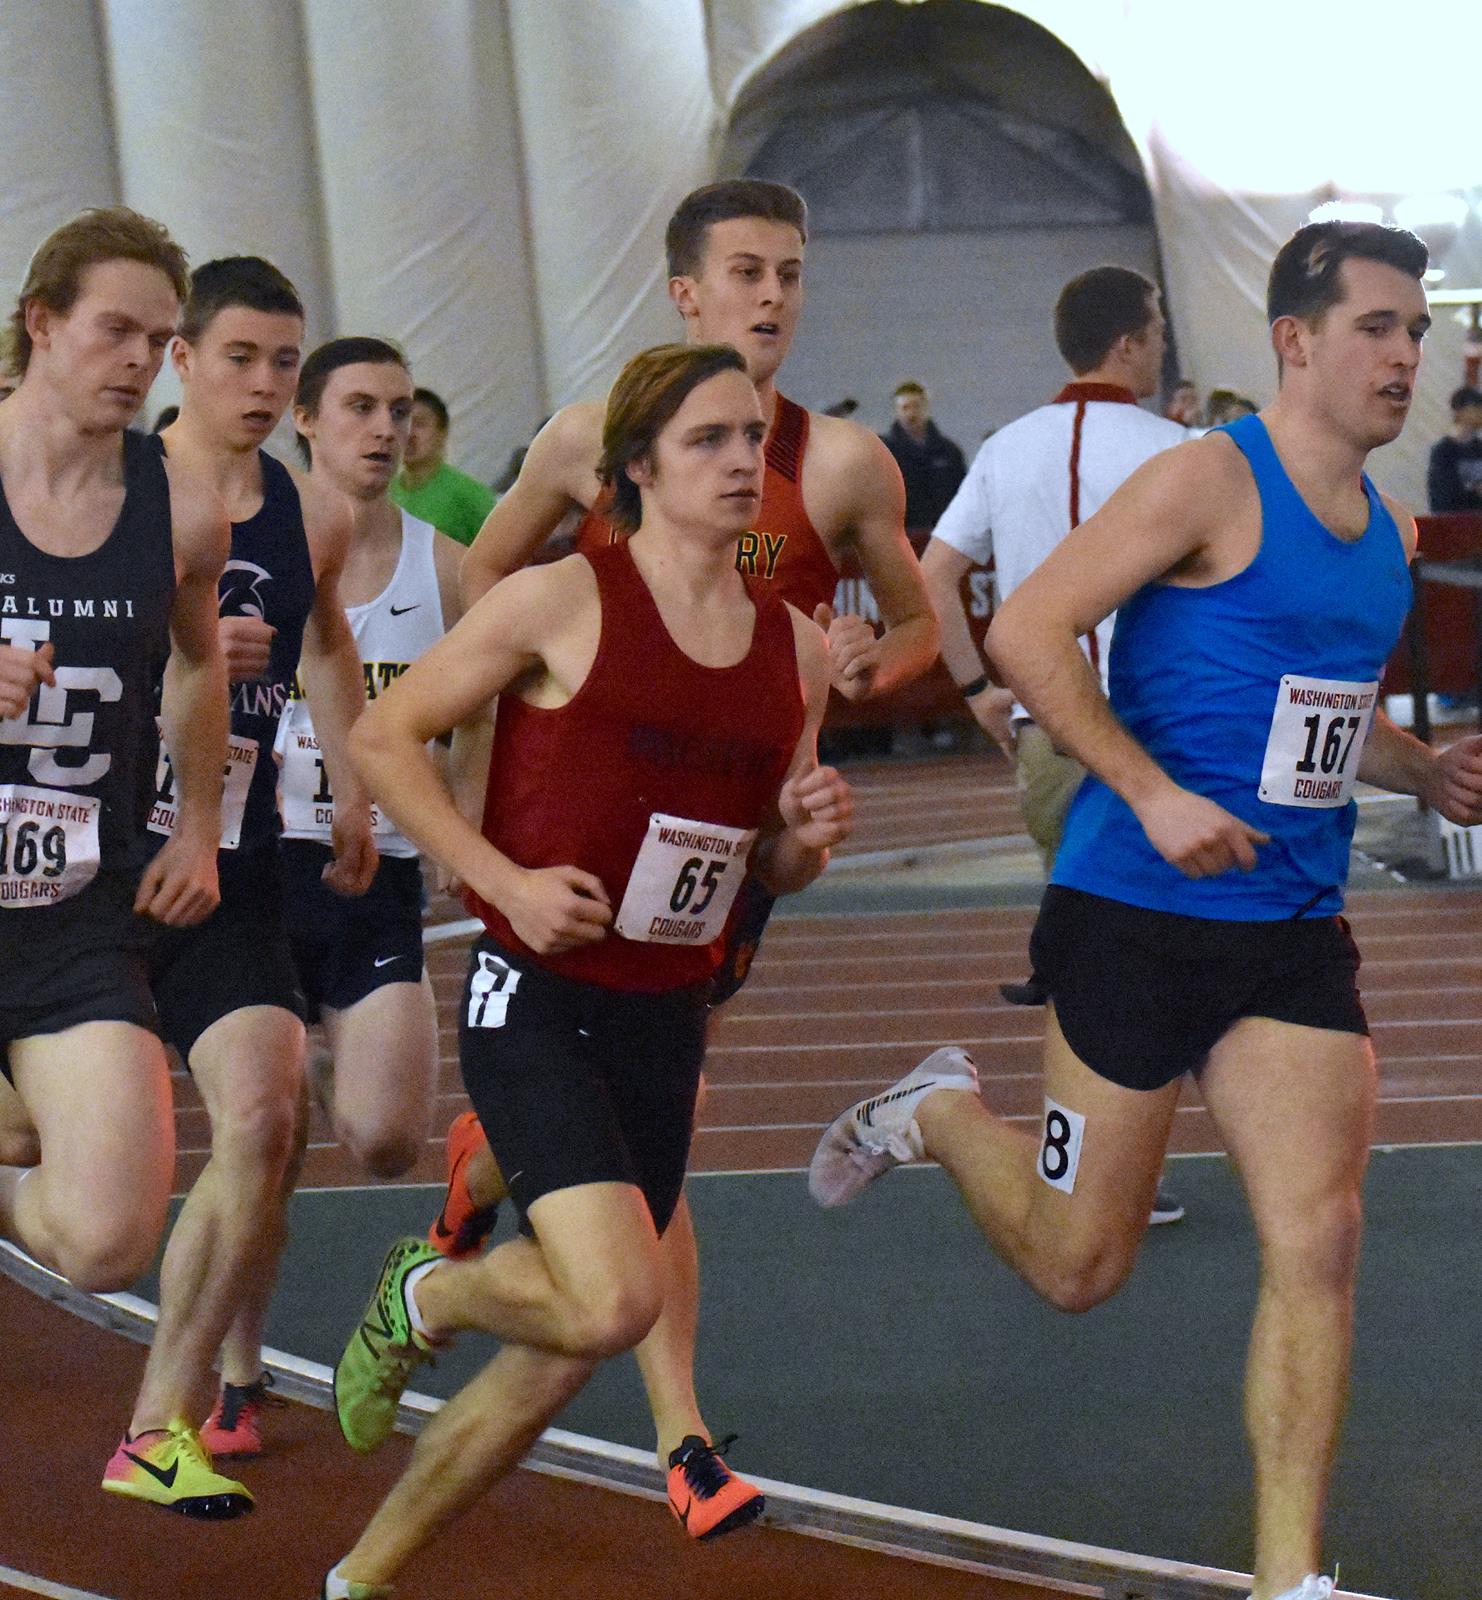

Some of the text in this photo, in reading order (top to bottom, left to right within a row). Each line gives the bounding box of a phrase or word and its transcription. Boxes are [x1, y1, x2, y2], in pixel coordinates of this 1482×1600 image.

[1, 595, 134, 618] ALUMNI
[1289, 688, 1356, 710] WASHINGTON
[1296, 713, 1361, 775] 167
[1293, 778, 1343, 800] COUGARS
[57, 803, 90, 824] STATE
[658, 827, 732, 857] WASHINGTON
[669, 857, 728, 915] 65
[648, 916, 706, 939] COUGARS
[1042, 1109, 1071, 1181] 8
